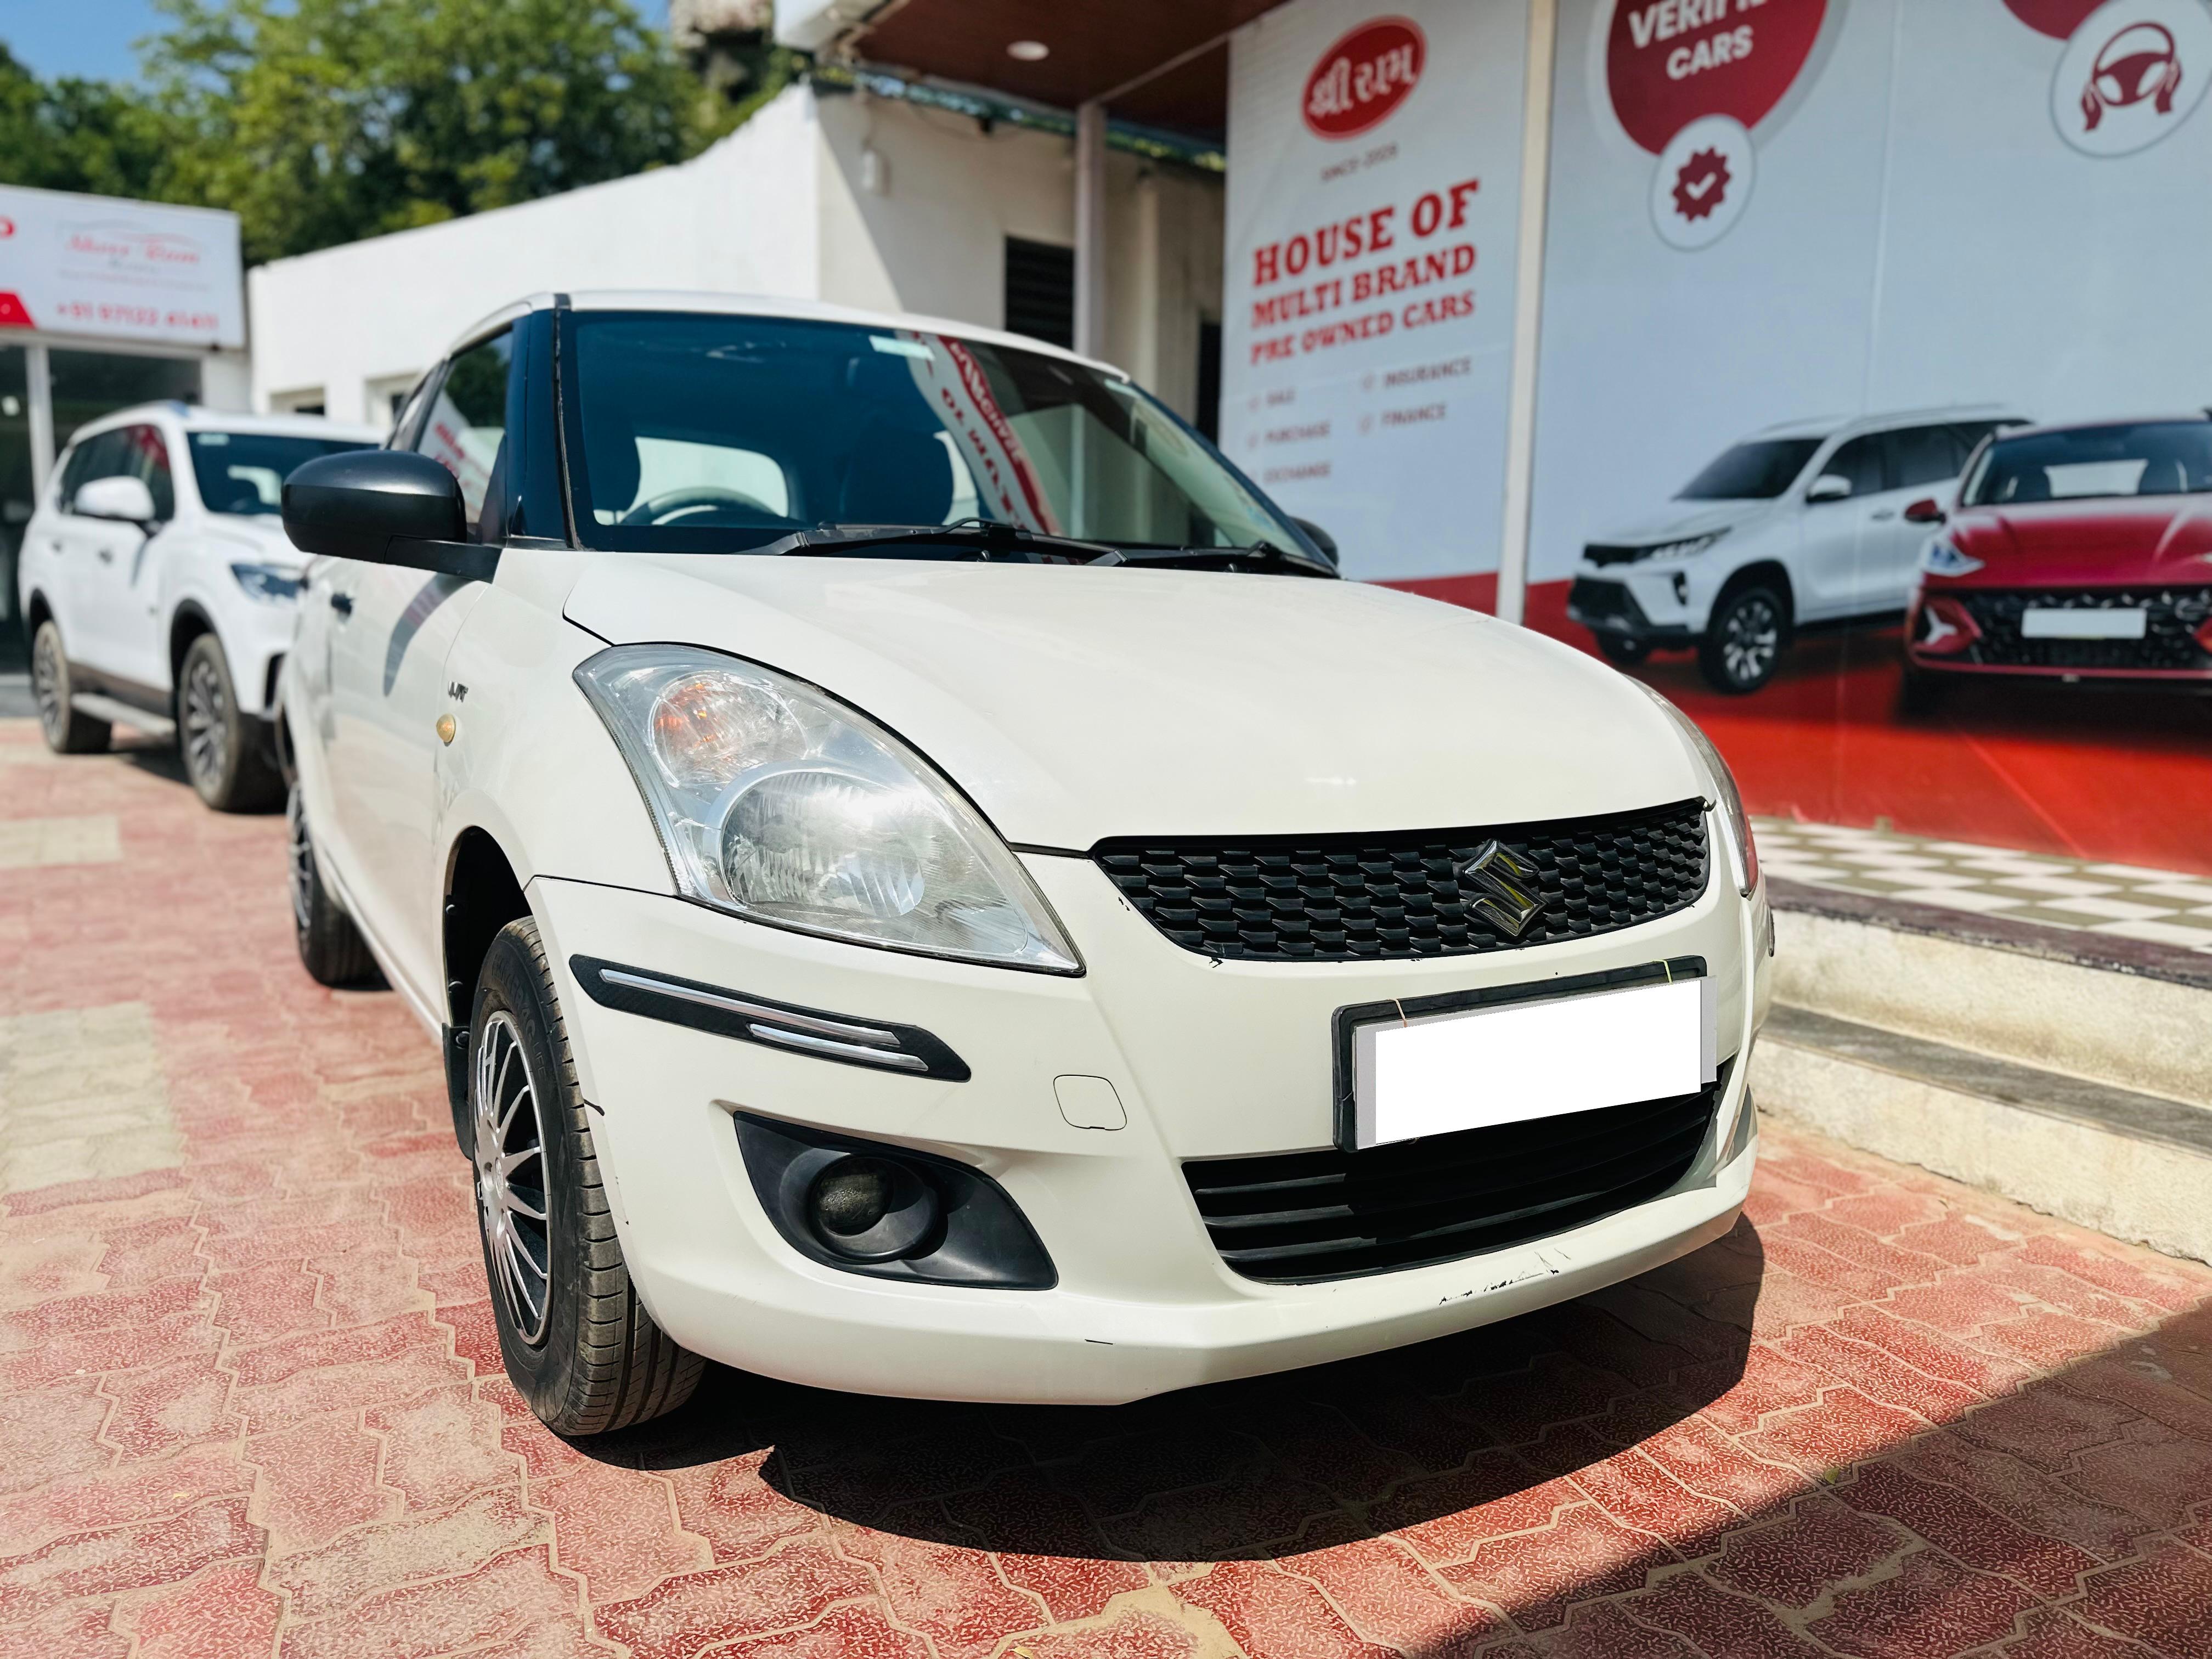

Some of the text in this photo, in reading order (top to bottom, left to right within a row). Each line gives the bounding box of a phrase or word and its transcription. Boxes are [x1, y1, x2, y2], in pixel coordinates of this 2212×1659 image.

[1666, 24, 1754, 80] CARS
[1254, 179, 1479, 286] HOUSE OF
[1251, 244, 1475, 329] MULTI BRAND
[1250, 290, 1475, 365] PRE OWNED CARS
[1384, 357, 1471, 388] INSURANCE
[1380, 403, 1447, 426] FINANCE
